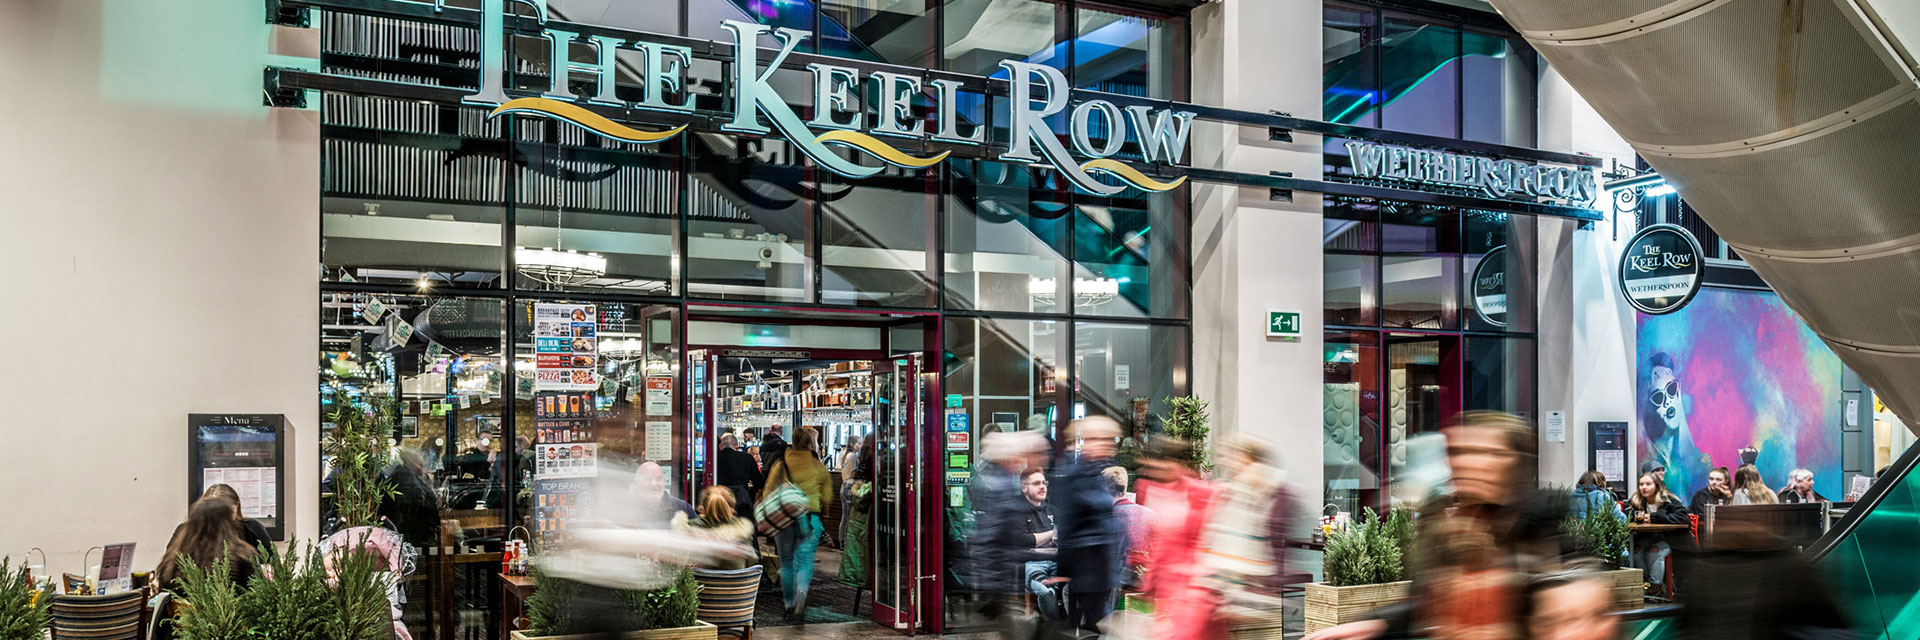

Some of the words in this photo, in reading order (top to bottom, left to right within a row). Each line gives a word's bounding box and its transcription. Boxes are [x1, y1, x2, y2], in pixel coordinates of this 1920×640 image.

[435, 0, 697, 111] THE
[720, 19, 983, 178] KEEL
[998, 59, 1197, 196] ROW
[1343, 140, 1597, 202] WETHERSPOON
[1643, 245, 1660, 254] THE
[1631, 256, 1661, 272] KEEL
[1663, 252, 1691, 268] ROW
[1631, 282, 1689, 292] WETHERSPOON
[225, 417, 250, 425] Menu
[558, 482, 589, 490] BRANDS
